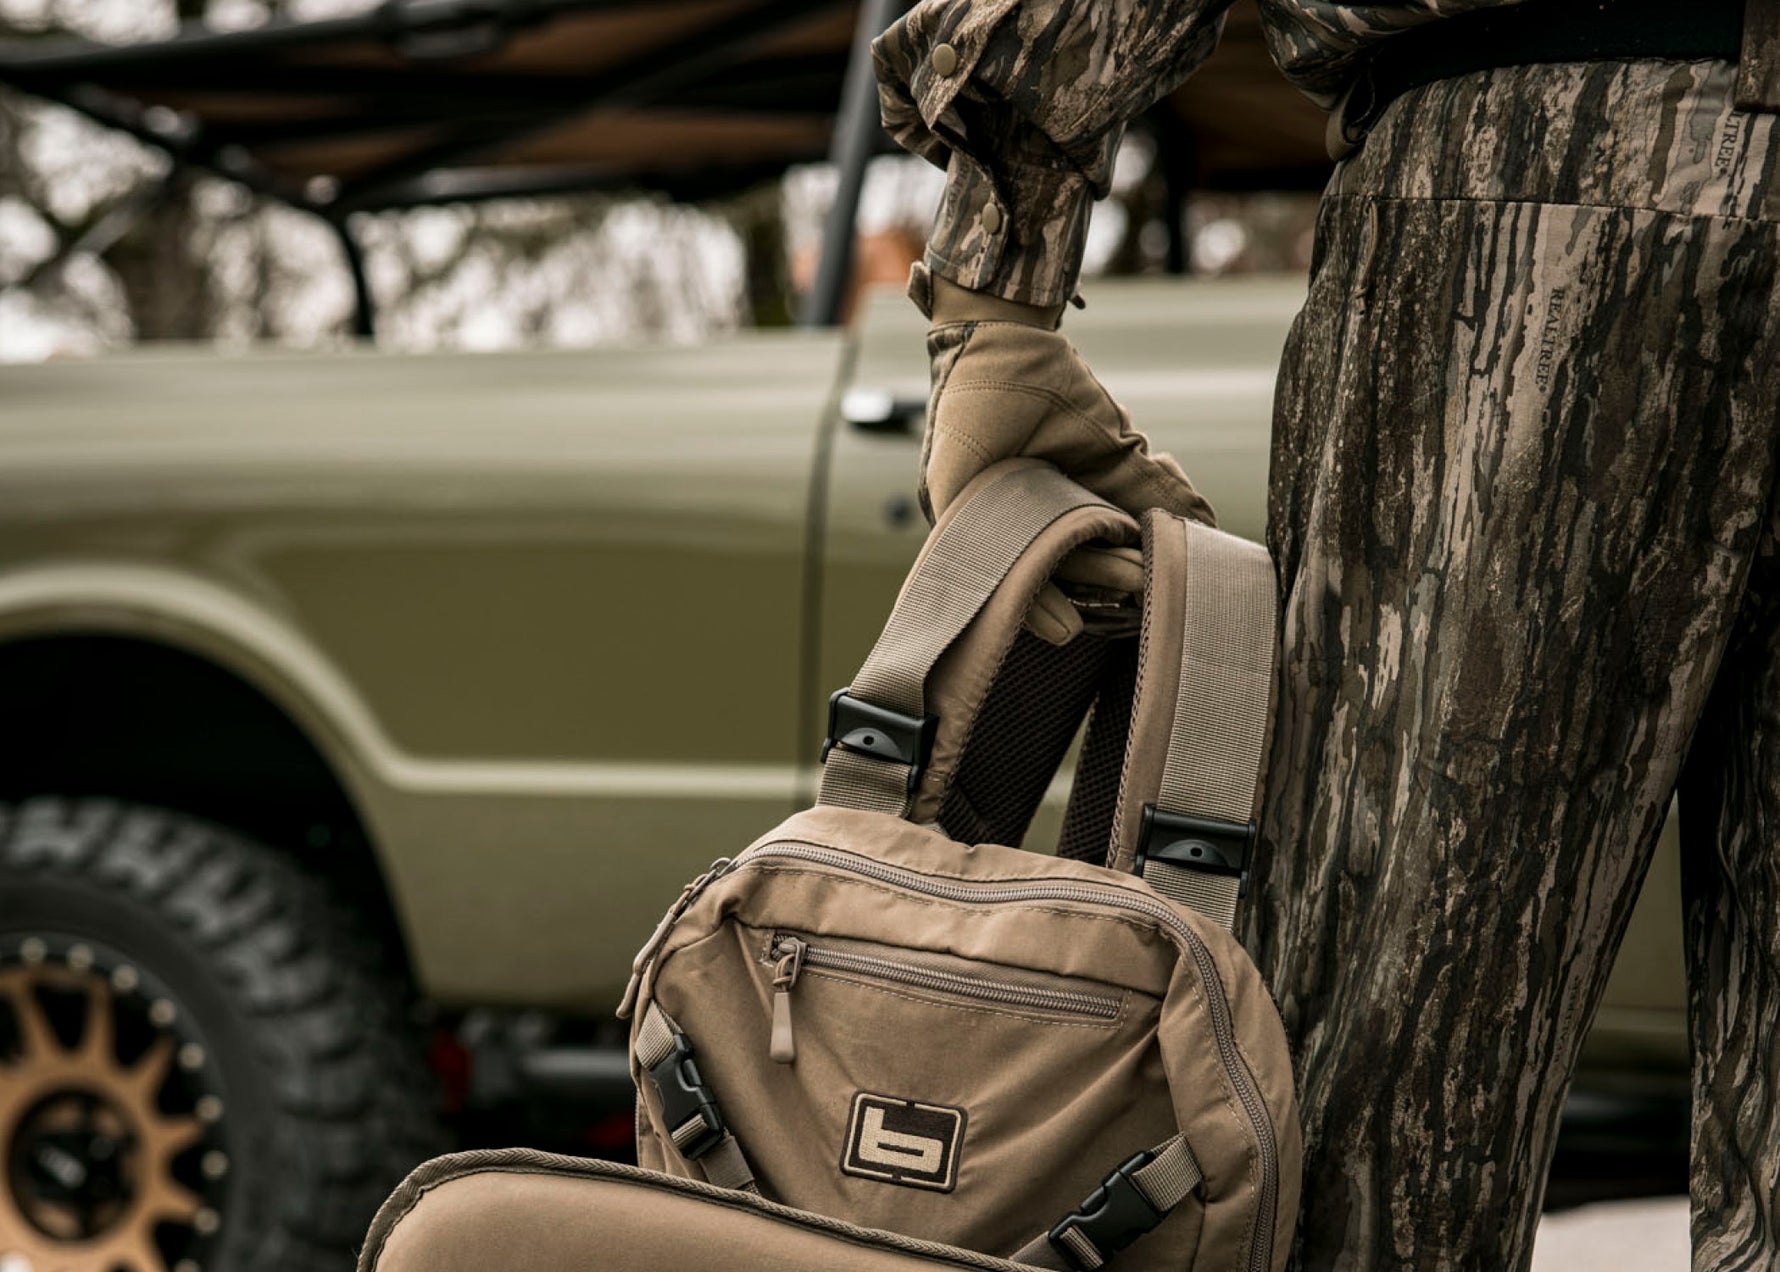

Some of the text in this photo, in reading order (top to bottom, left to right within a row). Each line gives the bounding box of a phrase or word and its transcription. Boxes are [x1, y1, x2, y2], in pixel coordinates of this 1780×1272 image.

[1714, 111, 1745, 167] LTREE
[1535, 287, 1565, 385] REALTREE
[858, 1105, 944, 1174] b
